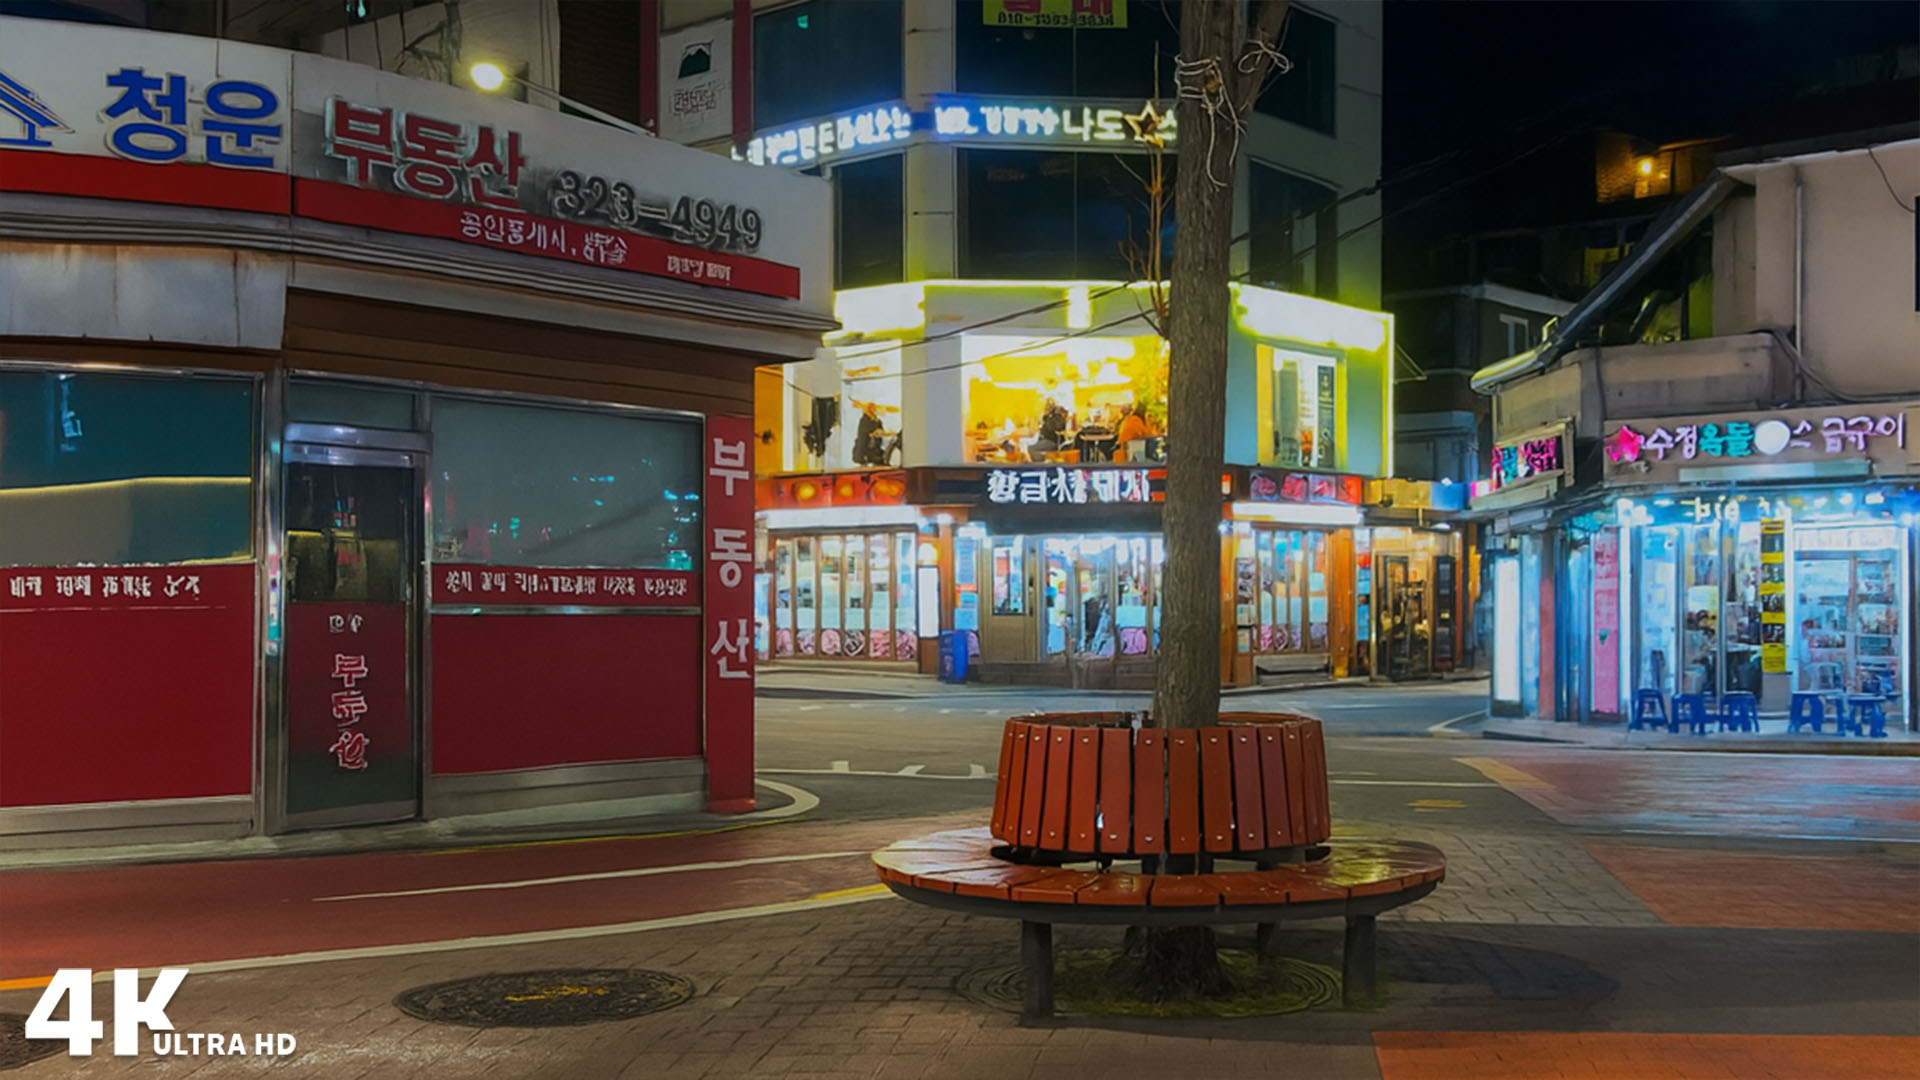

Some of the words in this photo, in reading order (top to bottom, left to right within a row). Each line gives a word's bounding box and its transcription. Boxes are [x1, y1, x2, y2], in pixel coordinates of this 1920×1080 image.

[105, 67, 282, 168] 청운
[329, 98, 526, 211] 부동산
[551, 169, 763, 253] 323-4949
[709, 437, 752, 679] 부동산
